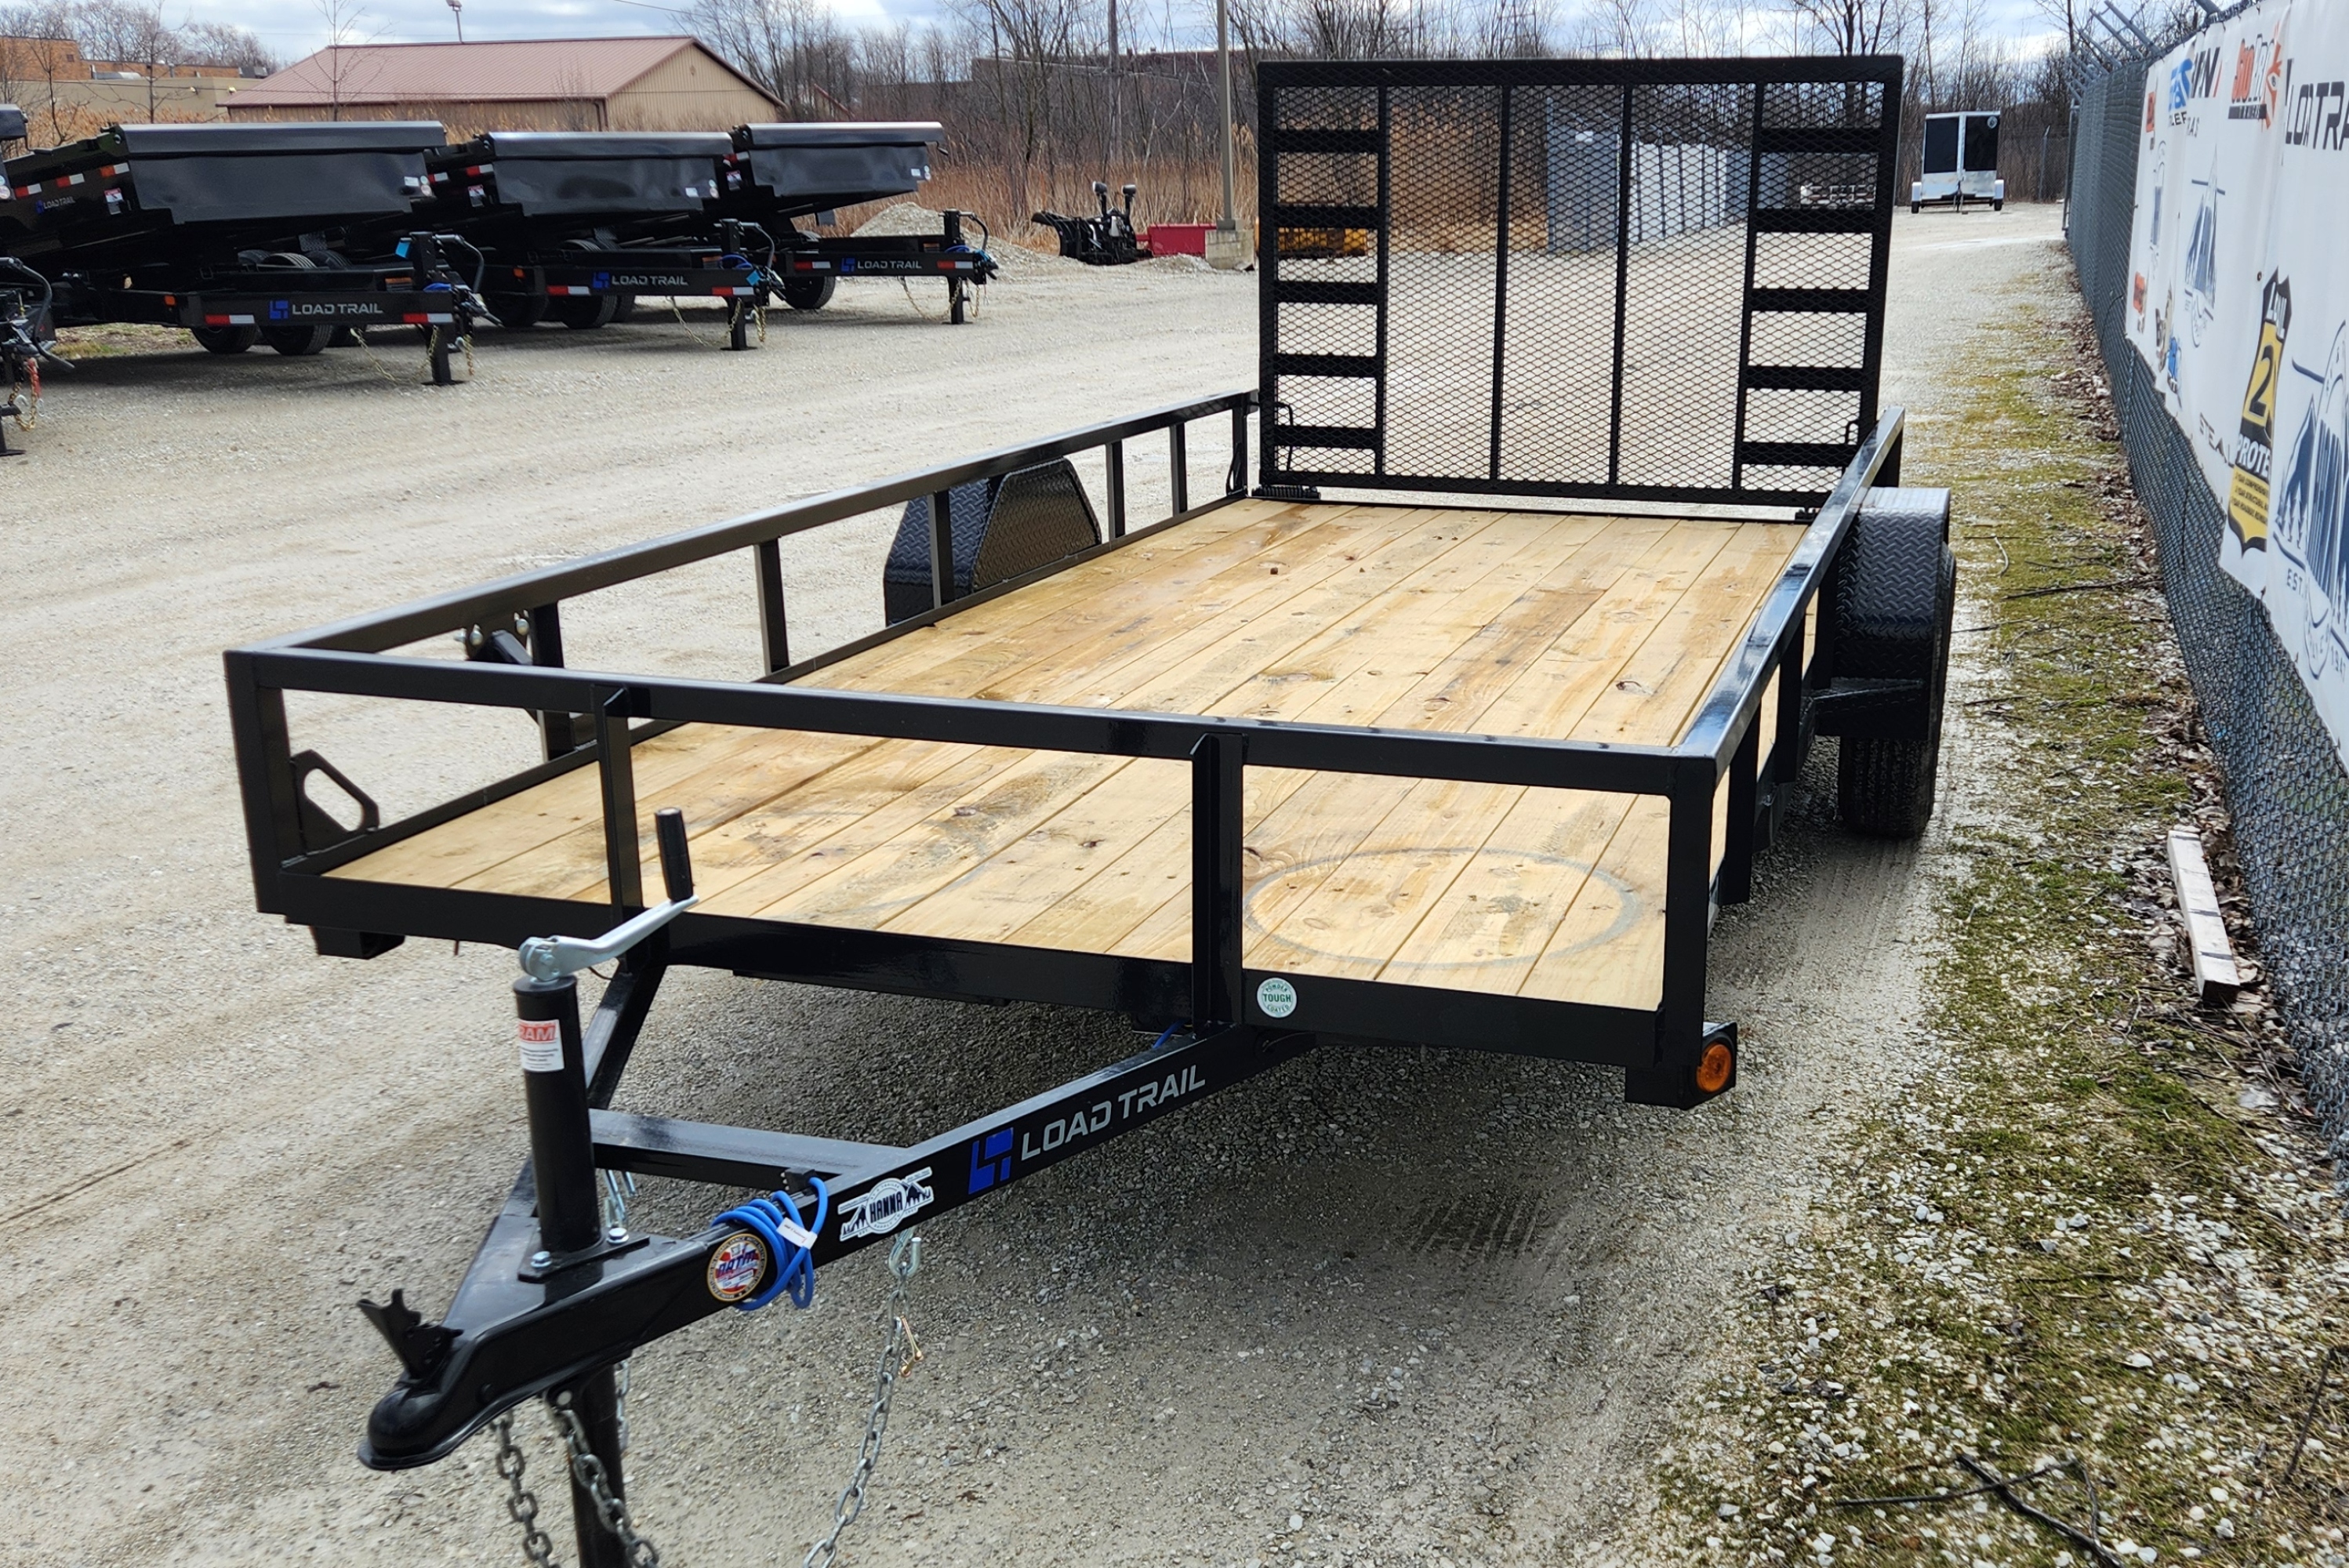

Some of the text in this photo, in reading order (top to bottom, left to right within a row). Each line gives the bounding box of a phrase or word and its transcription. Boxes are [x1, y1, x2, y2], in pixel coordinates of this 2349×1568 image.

[857, 260, 923, 270] LOAD TRAIL
[612, 275, 689, 286] LOAD TRAIL
[292, 303, 384, 315] LOAD TRAIL
[1262, 993, 1292, 1003] TOUGH
[1021, 1064, 1206, 1161] LOAD TRAIL
[869, 1190, 903, 1224] HANNA
